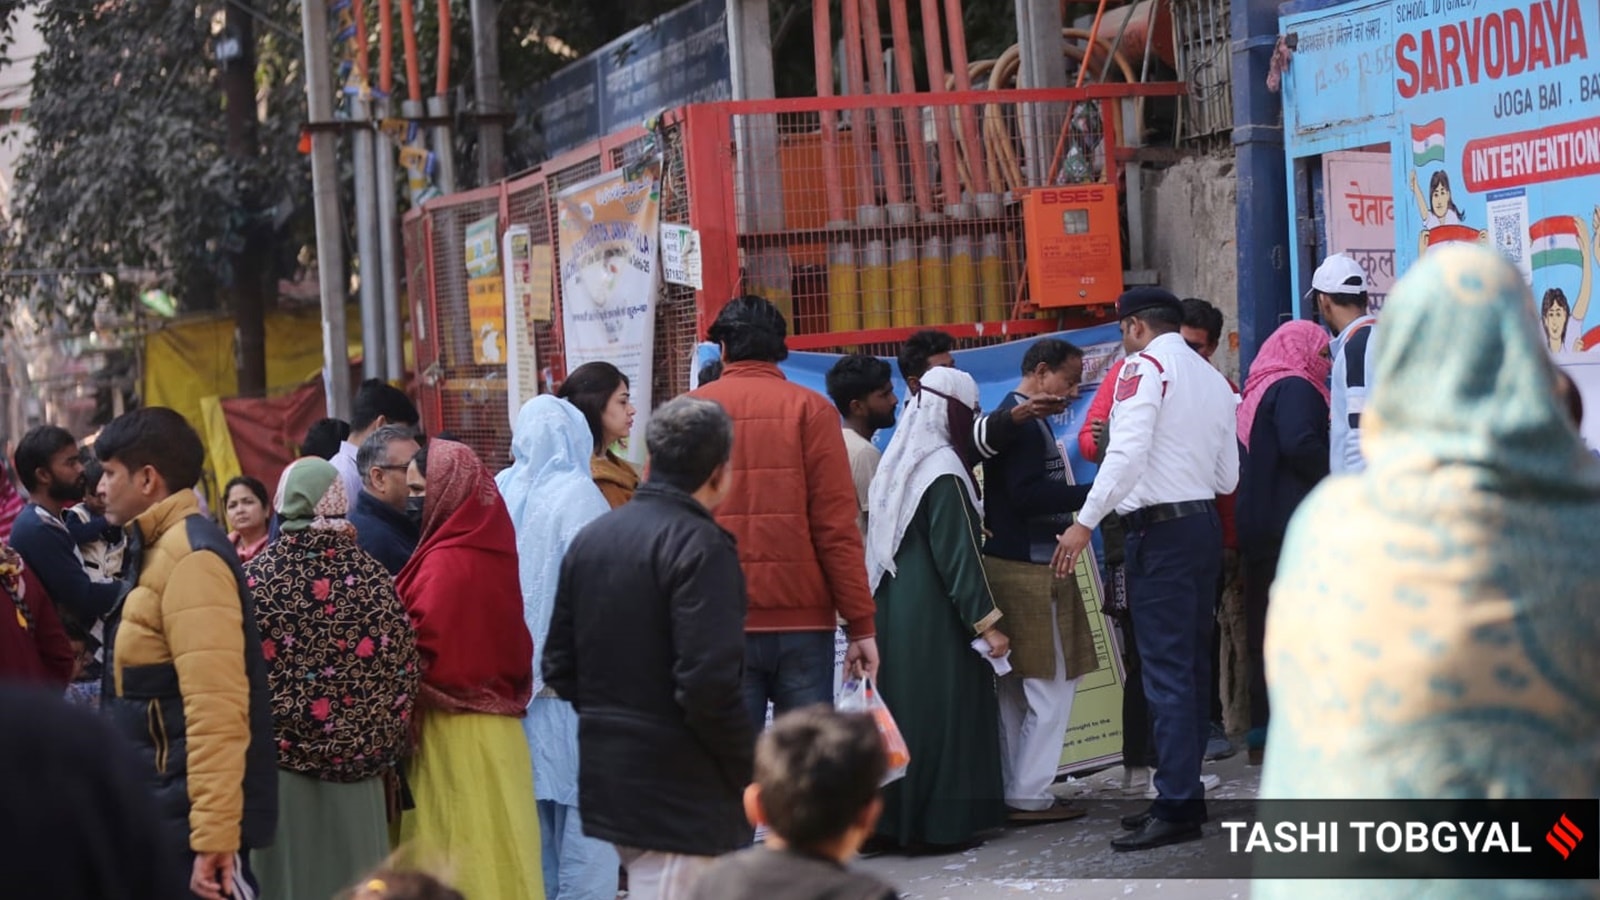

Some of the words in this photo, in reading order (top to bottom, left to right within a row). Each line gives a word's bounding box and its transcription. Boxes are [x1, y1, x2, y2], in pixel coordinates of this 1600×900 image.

[1396, 0, 1429, 23] SCHOOL
[1396, 0, 1588, 98] SARVODAYA
[1493, 87, 1533, 119] JOGA
[1538, 81, 1562, 111] BAI
[1579, 72, 1600, 103] BA
[1471, 126, 1600, 184] INTERVENTION
[1042, 189, 1104, 204] BSES
